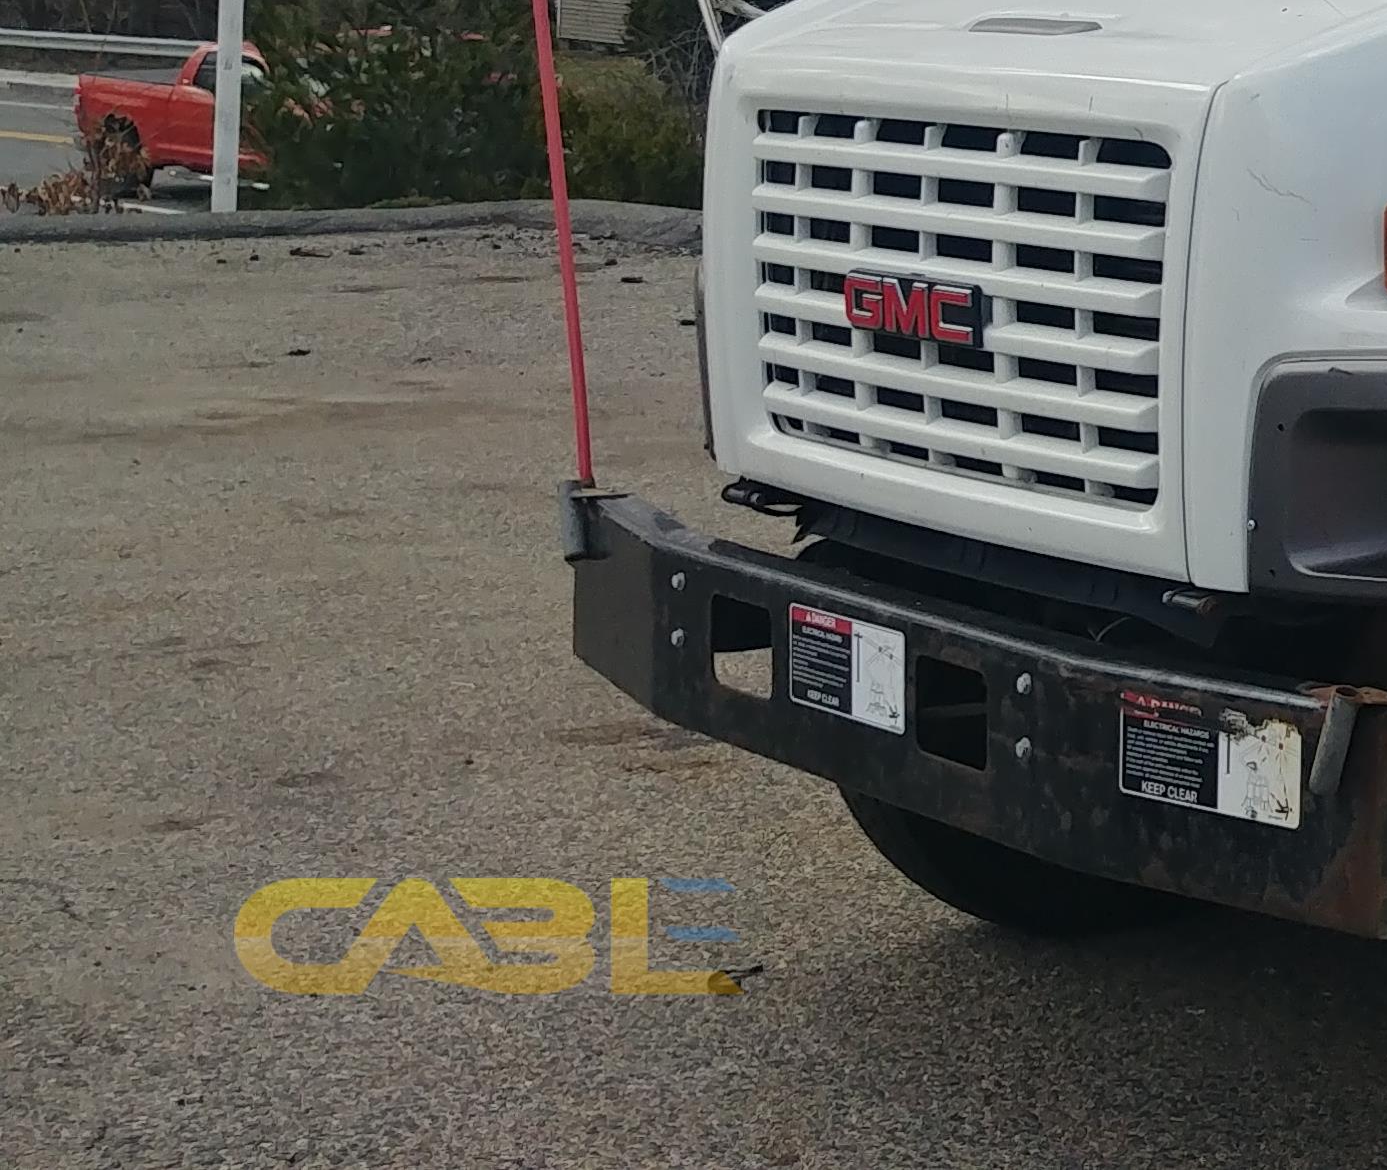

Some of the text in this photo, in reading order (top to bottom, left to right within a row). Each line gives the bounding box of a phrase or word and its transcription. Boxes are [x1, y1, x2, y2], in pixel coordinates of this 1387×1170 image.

[843, 272, 974, 345] GMC
[811, 612, 837, 629] DANGER
[821, 692, 840, 707] CLEAR
[1143, 719, 1180, 734] ELECTRICAL
[1141, 780, 1199, 804] KEEP CLEAR
